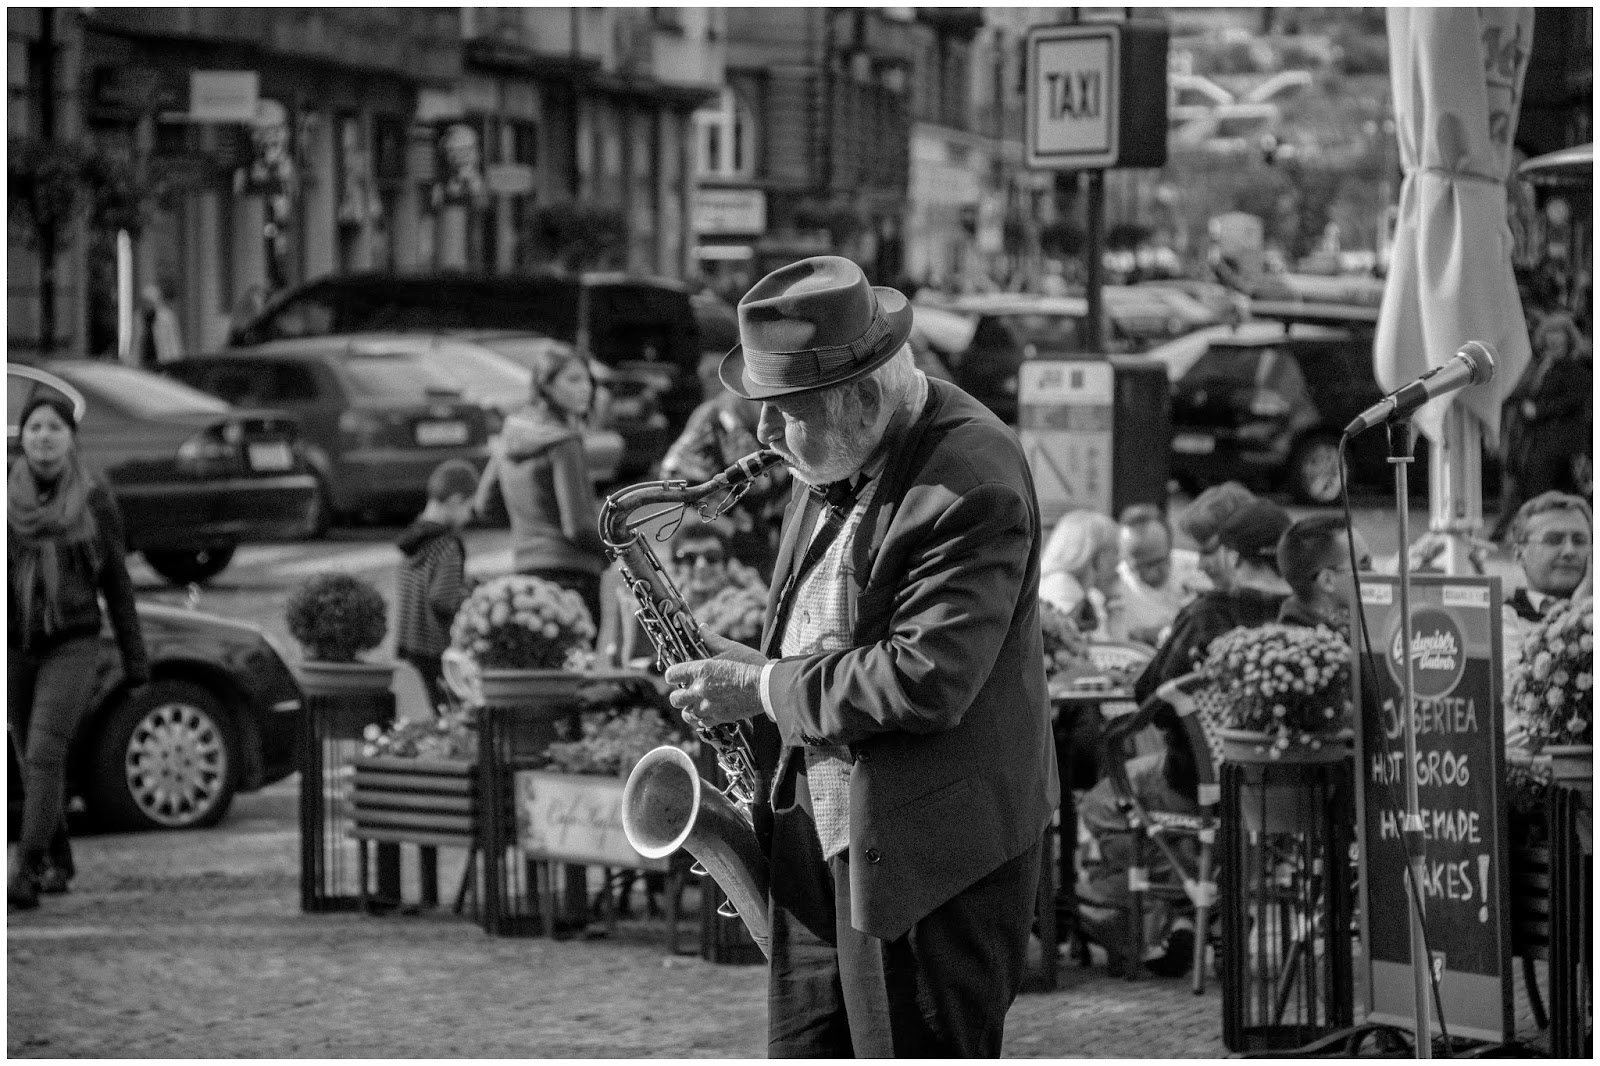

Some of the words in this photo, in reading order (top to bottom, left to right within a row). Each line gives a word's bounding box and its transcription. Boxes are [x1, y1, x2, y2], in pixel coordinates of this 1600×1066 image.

[1045, 69, 1101, 121] TAXI
[1371, 751, 1404, 786] HOT
[1415, 750, 1470, 787] GROG
[1380, 808, 1482, 843] HOEMADE
